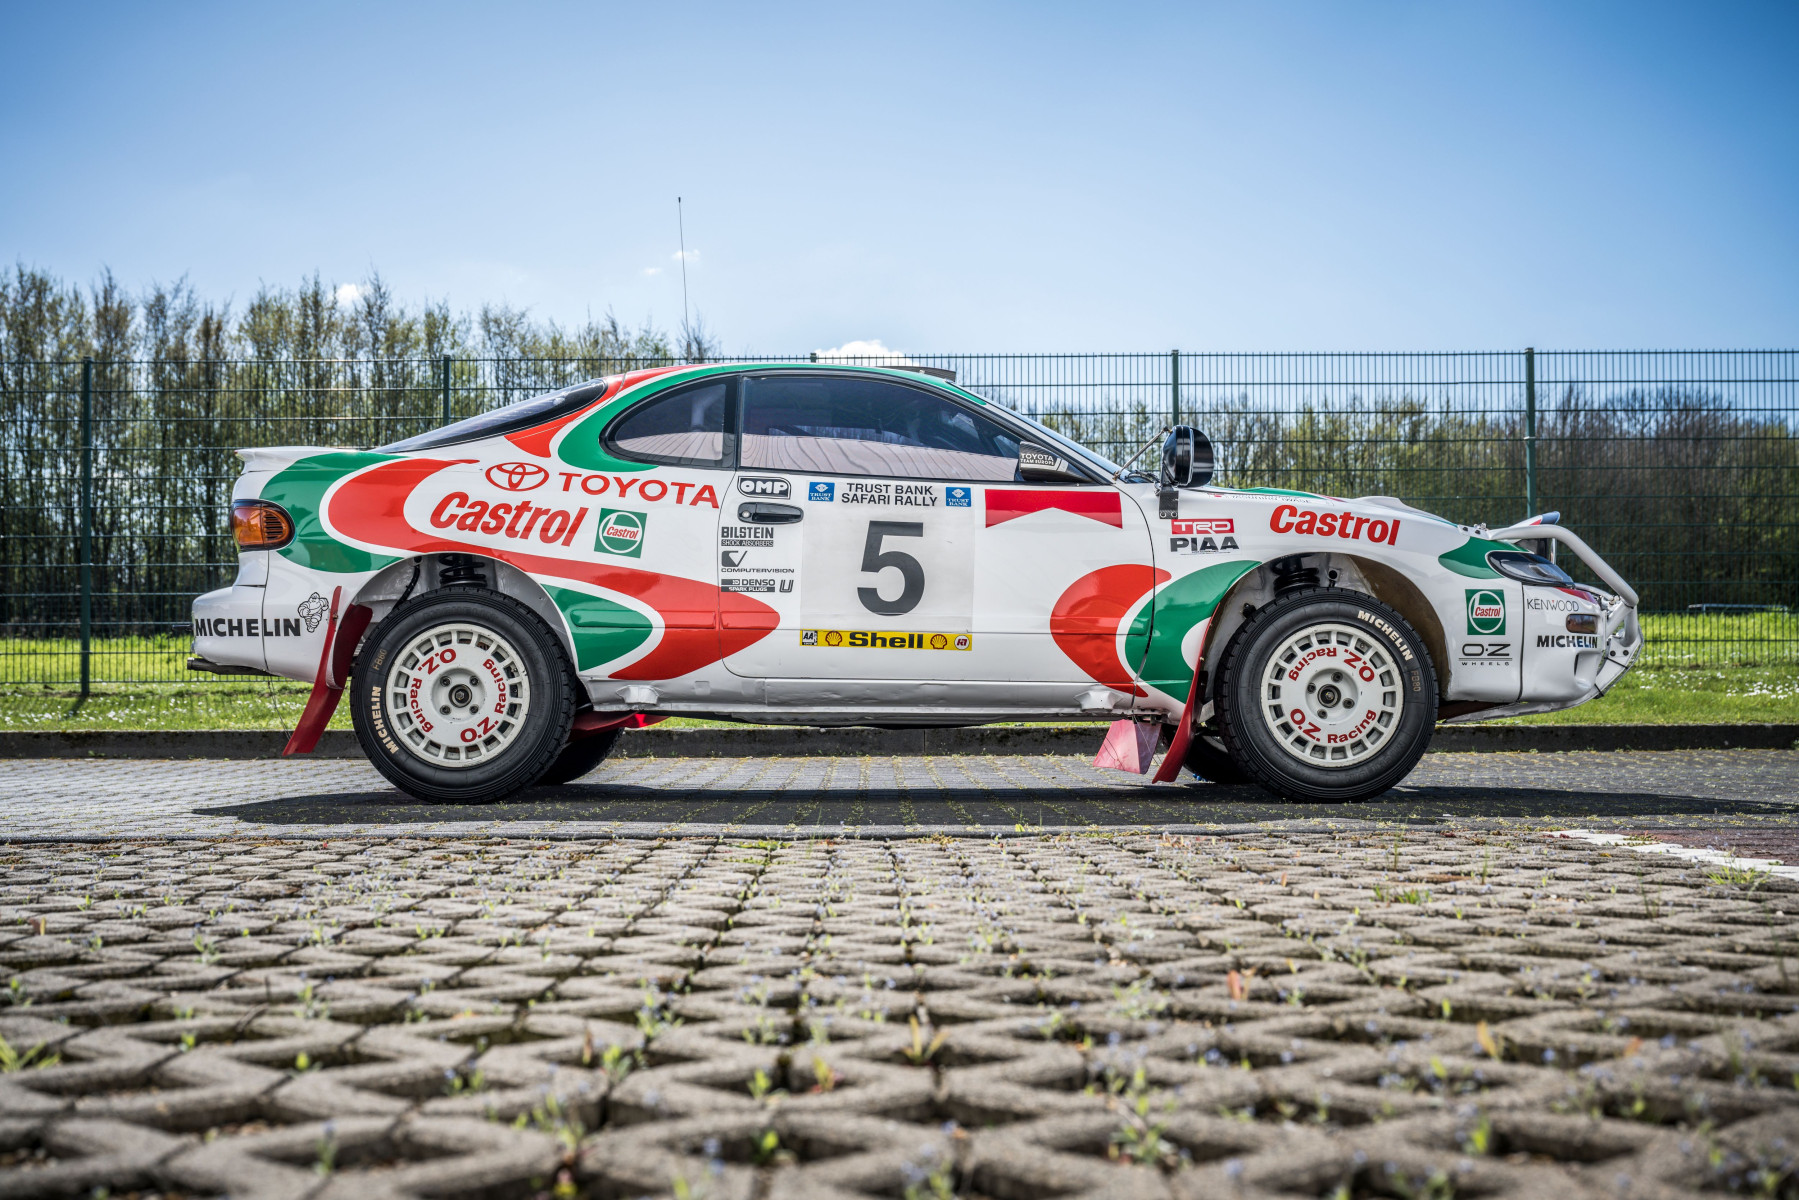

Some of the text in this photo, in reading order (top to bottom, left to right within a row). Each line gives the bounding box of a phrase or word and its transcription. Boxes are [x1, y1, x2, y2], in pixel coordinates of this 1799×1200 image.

[1021, 453, 1054, 461] TOYOTA
[558, 472, 720, 509] TOYOTA
[740, 480, 788, 494] OMP
[846, 482, 934, 496] TRUST BANK
[841, 493, 938, 507] SAFARI RALLY
[429, 491, 589, 547] Castrol
[1269, 504, 1401, 546] Castrol
[606, 525, 640, 540] Castrol
[721, 526, 774, 539] BILSTEIN
[1173, 521, 1231, 534] TRD
[721, 539, 740, 547] SHOCK
[1170, 536, 1240, 552] PIAA
[857, 520, 925, 616] 5
[741, 578, 776, 587] DENSO
[1474, 606, 1501, 618] Castrol
[1526, 598, 1580, 612] KENWOOD
[195, 617, 301, 637] MICHELIN
[848, 631, 924, 648] Shell
[1357, 609, 1414, 662] MICHELIN
[1536, 635, 1598, 649] MICHELIN
[1288, 647, 1337, 682] Racing
[482, 658, 507, 714] Racing
[409, 677, 434, 733] Racing
[371, 686, 400, 755] MICHELIN
[1327, 709, 1377, 744] Racing
